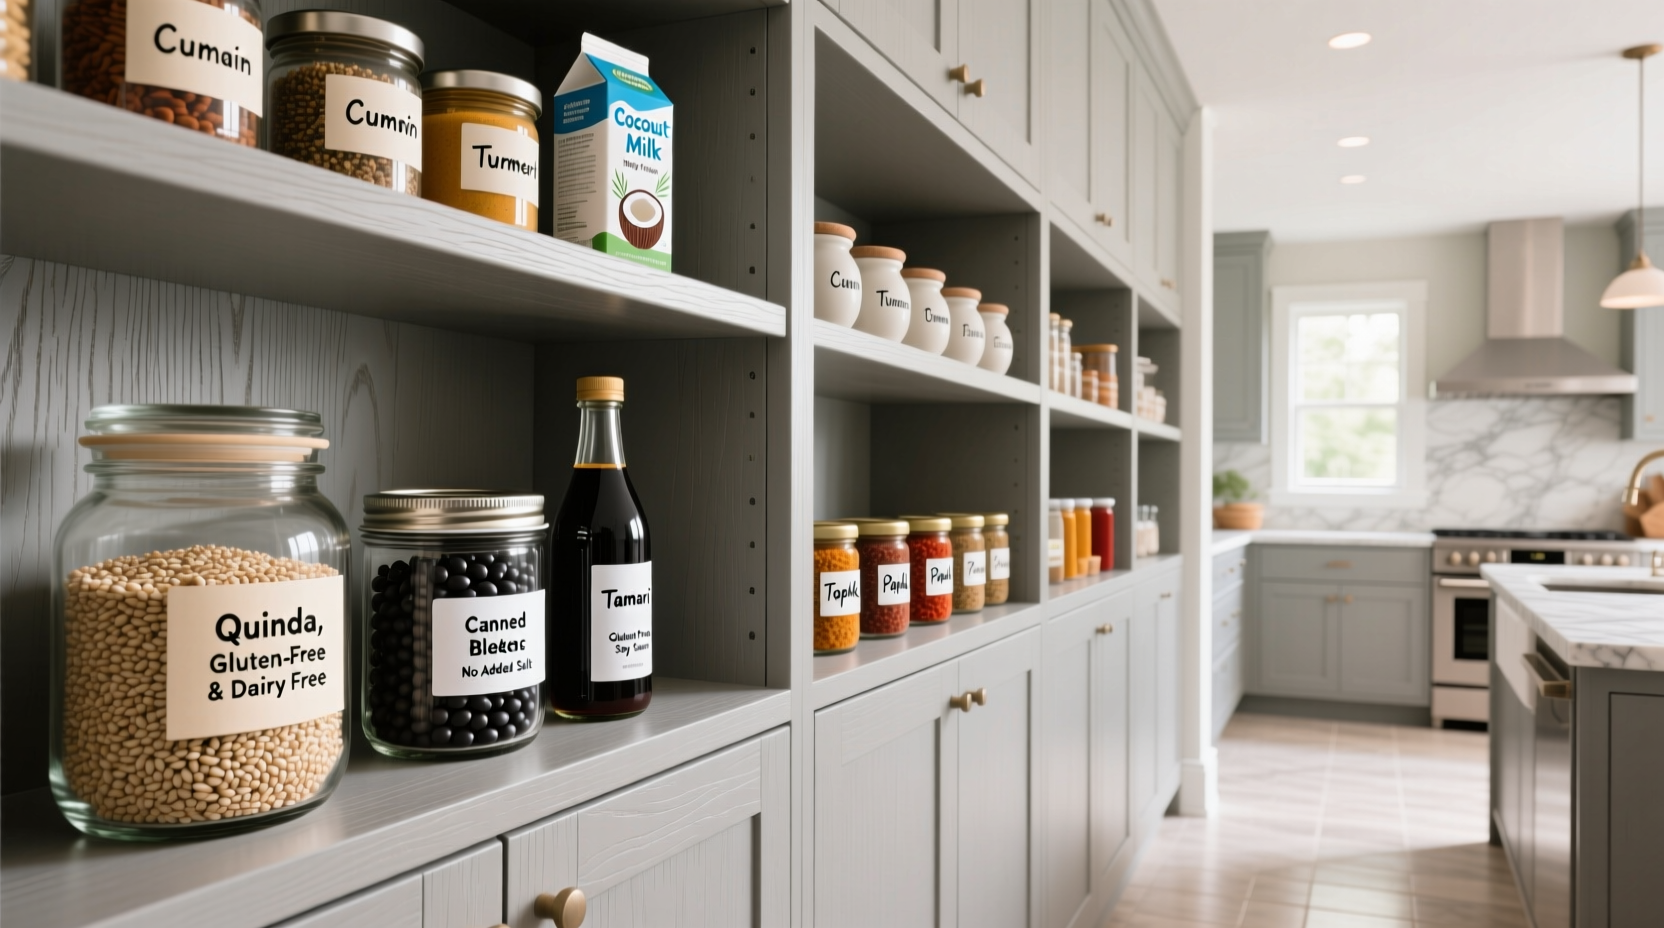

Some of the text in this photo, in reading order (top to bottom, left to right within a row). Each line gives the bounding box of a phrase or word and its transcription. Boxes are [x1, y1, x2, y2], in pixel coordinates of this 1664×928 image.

[626, 132, 662, 161] Milk
[601, 587, 651, 609] Tamari
[215, 606, 323, 647] Quinda,
[464, 610, 526, 633] Canned
[209, 645, 326, 674] Gluten-Free
[462, 665, 478, 678] No
[207, 671, 327, 701] & Dairy Free
